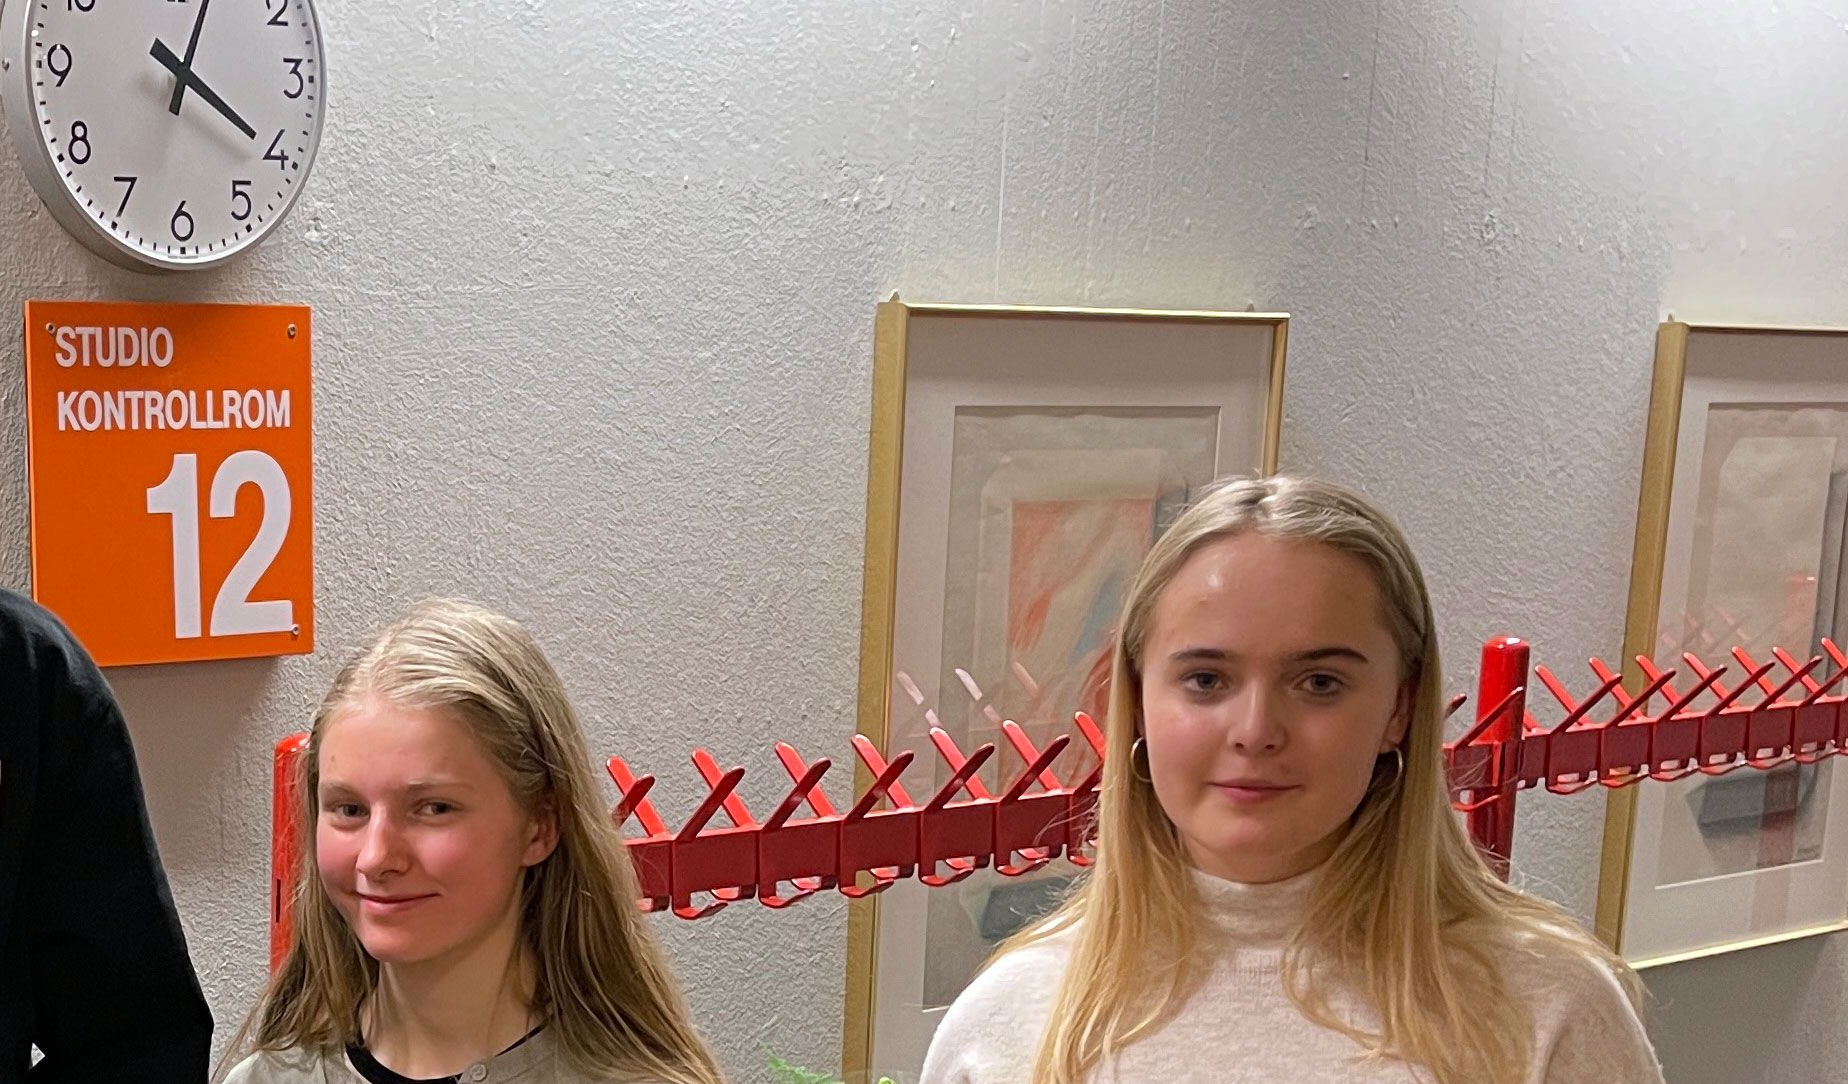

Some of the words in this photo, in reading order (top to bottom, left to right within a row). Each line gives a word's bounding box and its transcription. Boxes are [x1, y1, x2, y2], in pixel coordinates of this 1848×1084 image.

[46, 43, 73, 88] 9
[282, 57, 304, 99] 3
[67, 120, 92, 165] 8
[261, 129, 290, 171] 4
[112, 176, 138, 218] 7
[230, 180, 253, 221] 5
[170, 200, 195, 242] 6
[54, 326, 175, 369] STUDIO
[57, 388, 292, 432] KONTROLLROM
[146, 449, 294, 640] 12
